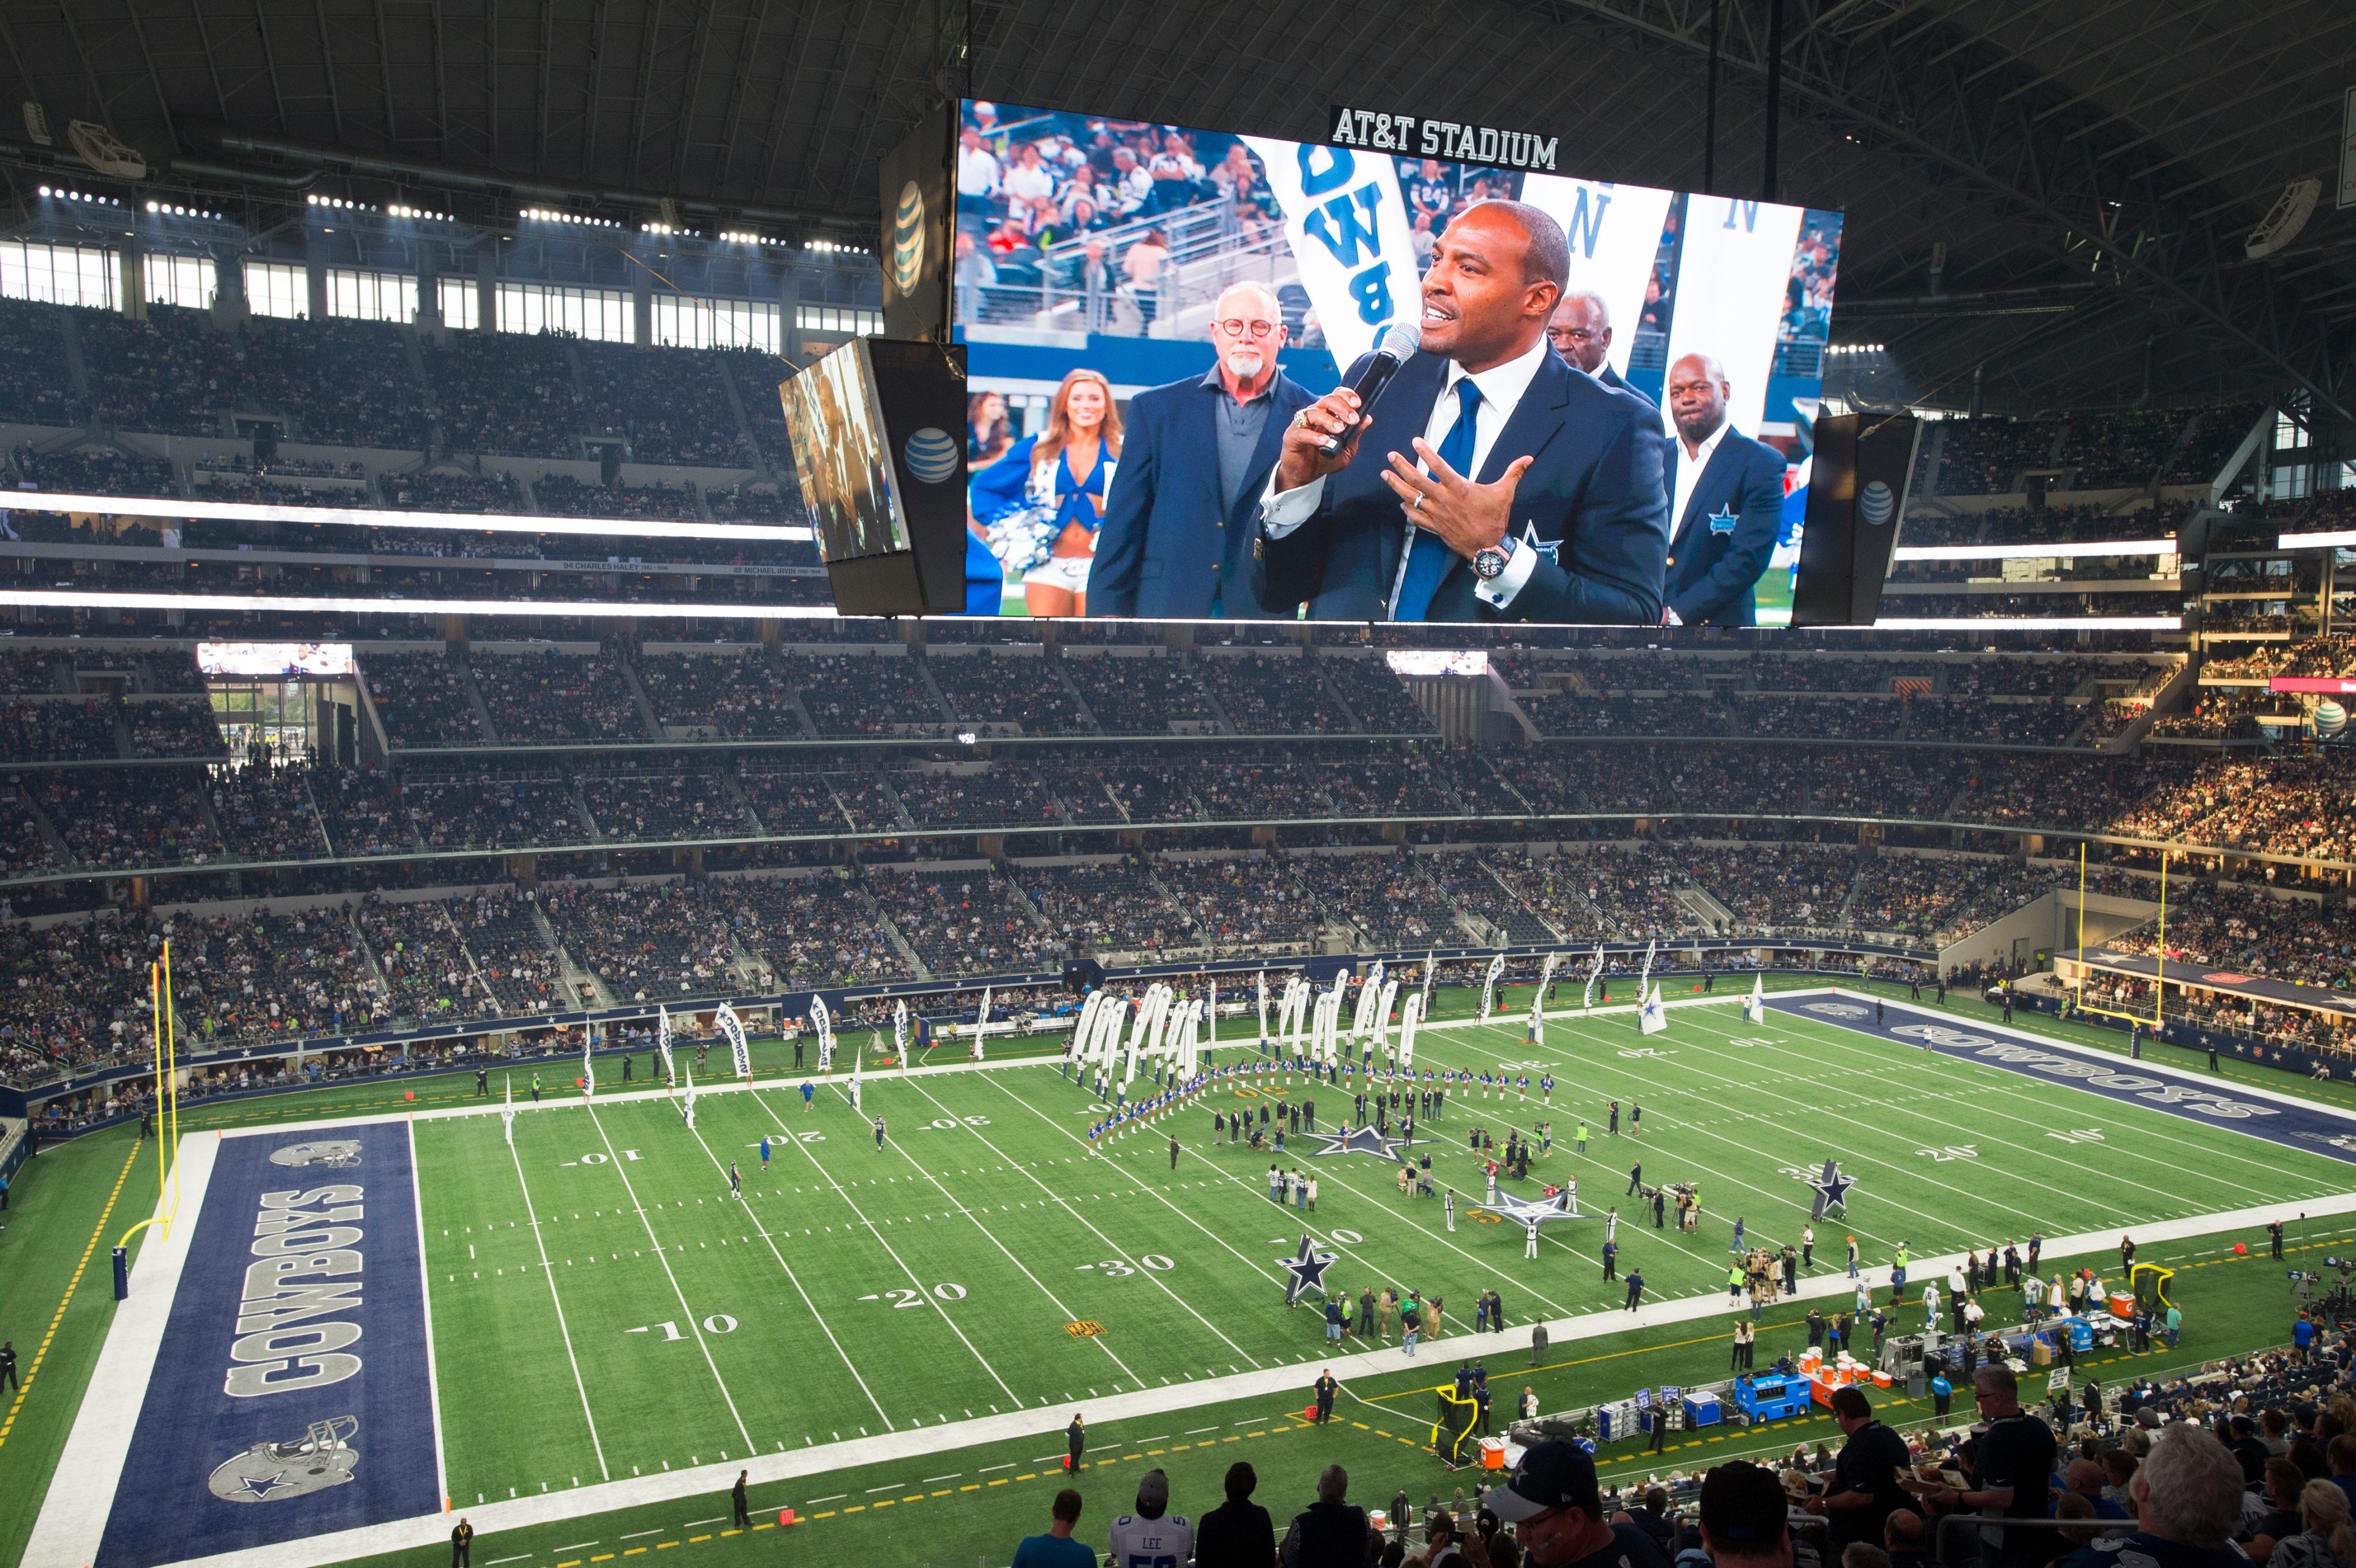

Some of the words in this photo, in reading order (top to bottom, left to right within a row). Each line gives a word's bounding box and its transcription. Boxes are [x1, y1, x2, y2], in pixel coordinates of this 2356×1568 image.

[1332, 108, 1415, 151] AT&T
[1421, 120, 1559, 171] STADIUM
[614, 563, 639, 571] HALEY
[725, 1015, 749, 1074] COWBOYS
[1891, 1024, 2281, 1118] COWBOYS
[932, 1116, 991, 1129] 30
[2044, 1129, 2105, 1144] 10
[581, 1149, 645, 1165] 10
[1914, 1146, 1979, 1162] 20
[1098, 1253, 1175, 1277] 30
[224, 1184, 363, 1397] COWBOYS
[885, 1282, 968, 1308] 20
[1858, 1283, 1864, 1294] 91
[1927, 1292, 1932, 1300] 6
[2126, 1302, 2133, 1312] G
[654, 1314, 739, 1342] 10
[1309, 1407, 1317, 1417] 30
[1481, 1450, 1487, 1461] G
[1143, 1537, 1162, 1550] LEE
